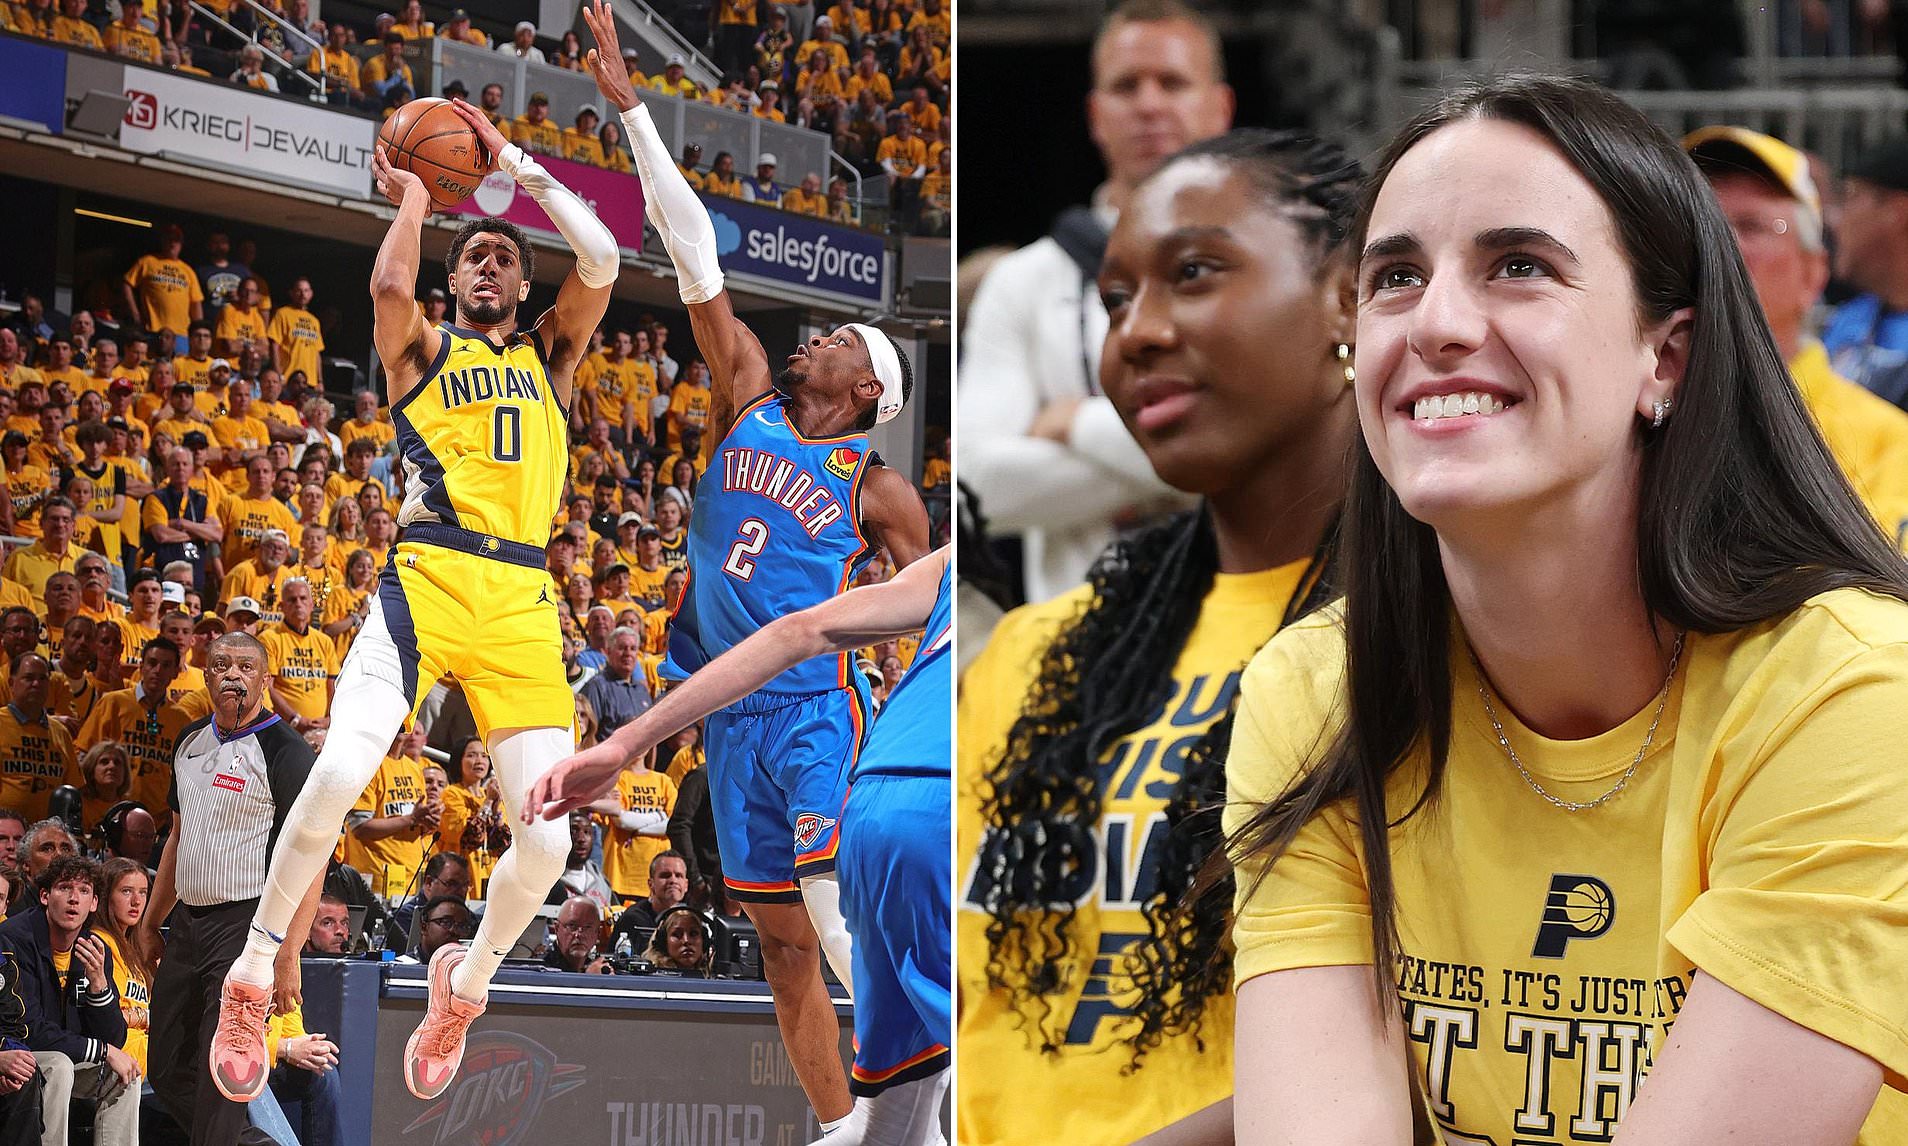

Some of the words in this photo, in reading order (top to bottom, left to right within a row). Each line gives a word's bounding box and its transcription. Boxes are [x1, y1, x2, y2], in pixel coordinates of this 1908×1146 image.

[163, 105, 242, 141] KRIEG
[254, 124, 371, 169] DEVAULT
[747, 225, 878, 285] salesforce
[439, 367, 545, 410] INDIAN
[494, 405, 521, 462] 0
[723, 447, 844, 540] THUNDER
[722, 517, 771, 582] 2
[294, 648, 314, 657] BUT
[281, 667, 327, 679] INDIANA
[21, 735, 49, 749] BUT
[122, 730, 157, 746] THIS
[10, 746, 45, 762] THIS
[50, 751, 62, 764] IS
[214, 777, 244, 790] Emirates
[388, 789, 413, 800] THIS
[393, 776, 413, 786] BUT
[632, 786, 657, 795] BUT
[1501, 969, 1560, 1011] IT'S
[1571, 976, 1647, 1017] JUST
[751, 1041, 801, 1087] GAM
[606, 1101, 766, 1146] THUNDER
[776, 1124, 796, 1146] AT
